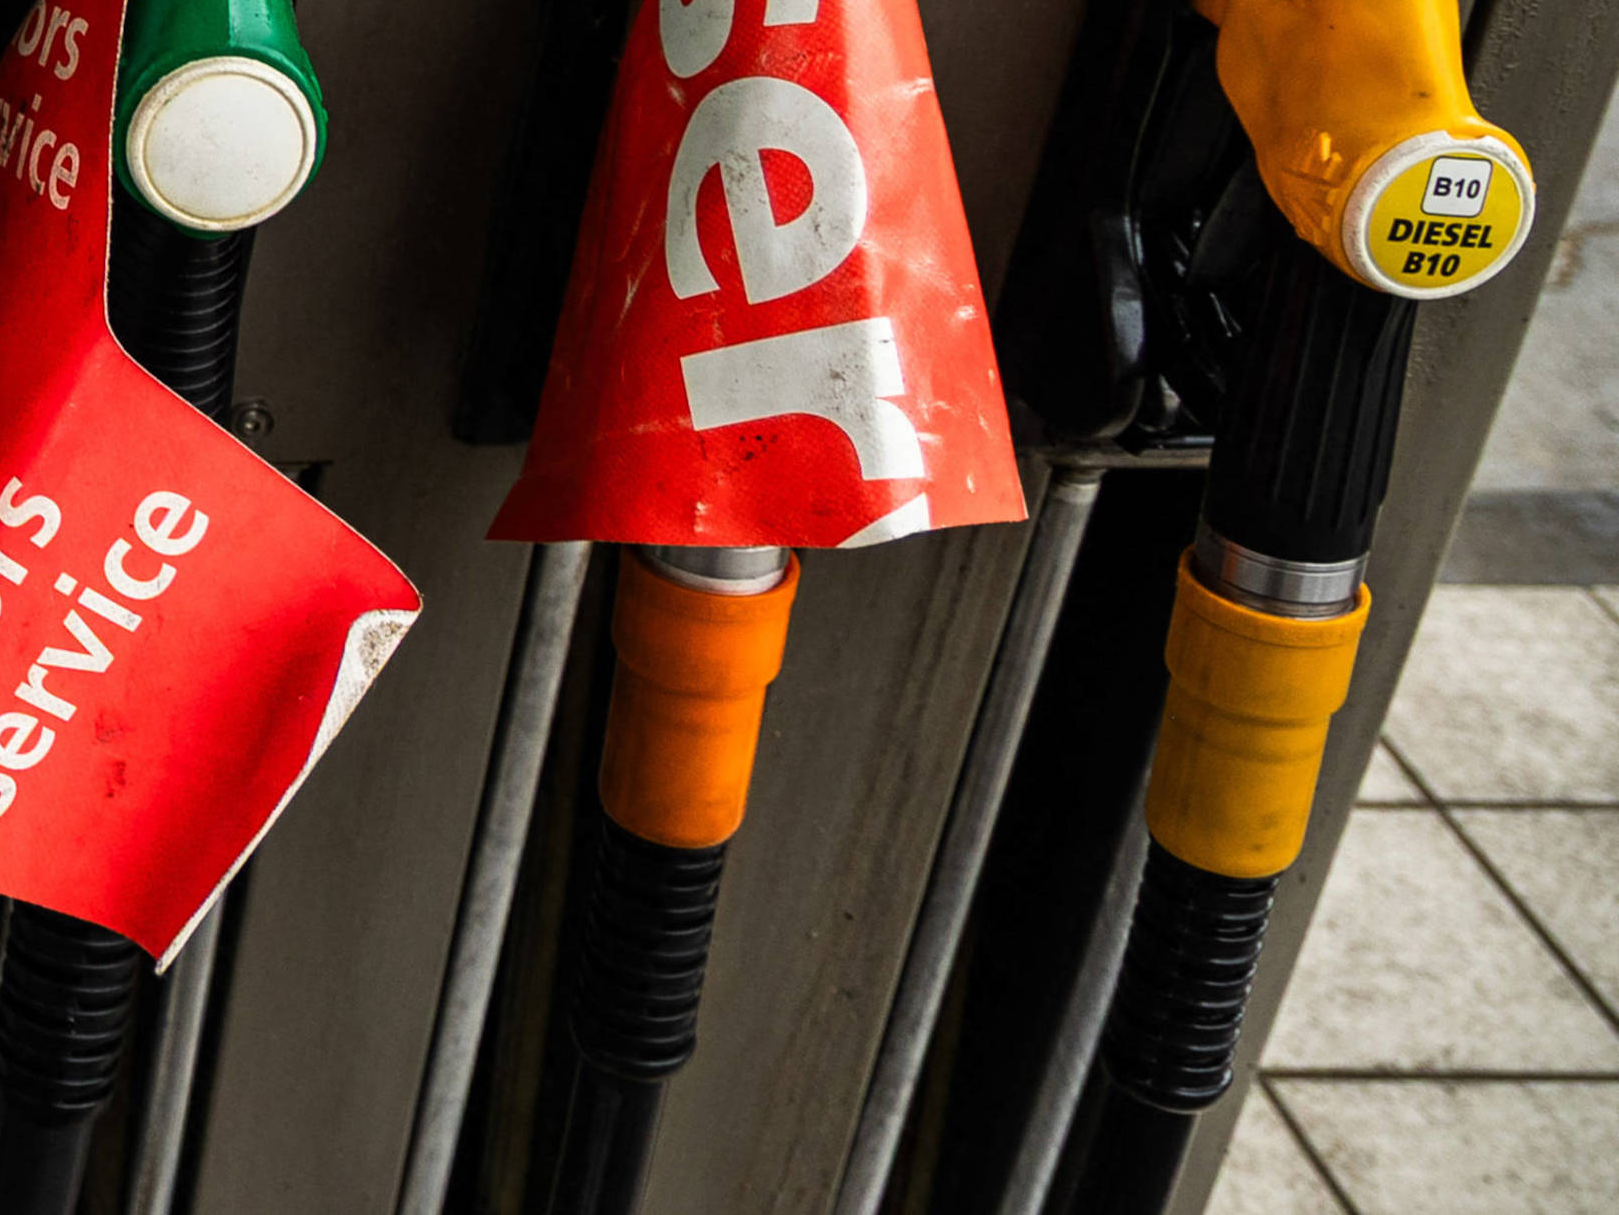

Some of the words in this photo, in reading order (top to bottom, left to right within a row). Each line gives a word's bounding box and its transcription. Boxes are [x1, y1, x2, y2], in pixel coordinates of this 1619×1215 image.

[1432, 177, 1482, 199] B10
[1387, 218, 1493, 249] DIESEL
[1401, 251, 1460, 277] B10
